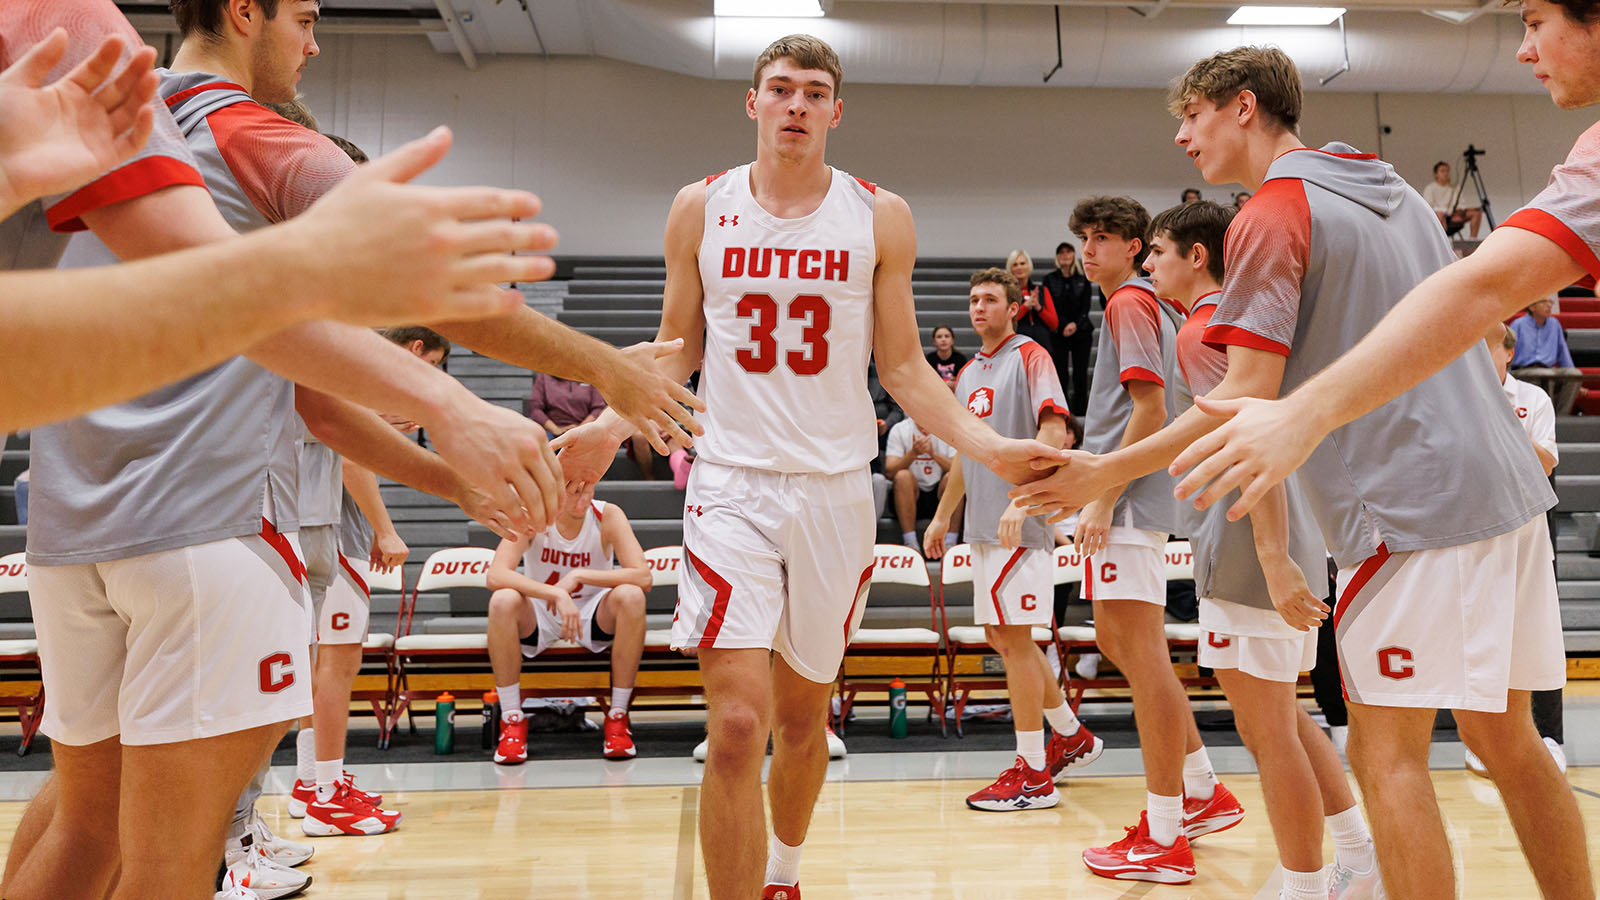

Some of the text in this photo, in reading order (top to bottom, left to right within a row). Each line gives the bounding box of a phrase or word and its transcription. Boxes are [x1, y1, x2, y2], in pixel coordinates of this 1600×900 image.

[721, 247, 850, 282] DUTCH
[735, 291, 833, 378] 33
[540, 547, 591, 568] DUTCH
[1101, 562, 1118, 584] C
[1020, 593, 1037, 612] C
[331, 611, 350, 631] C
[257, 650, 297, 695] C
[1376, 645, 1416, 681] C
